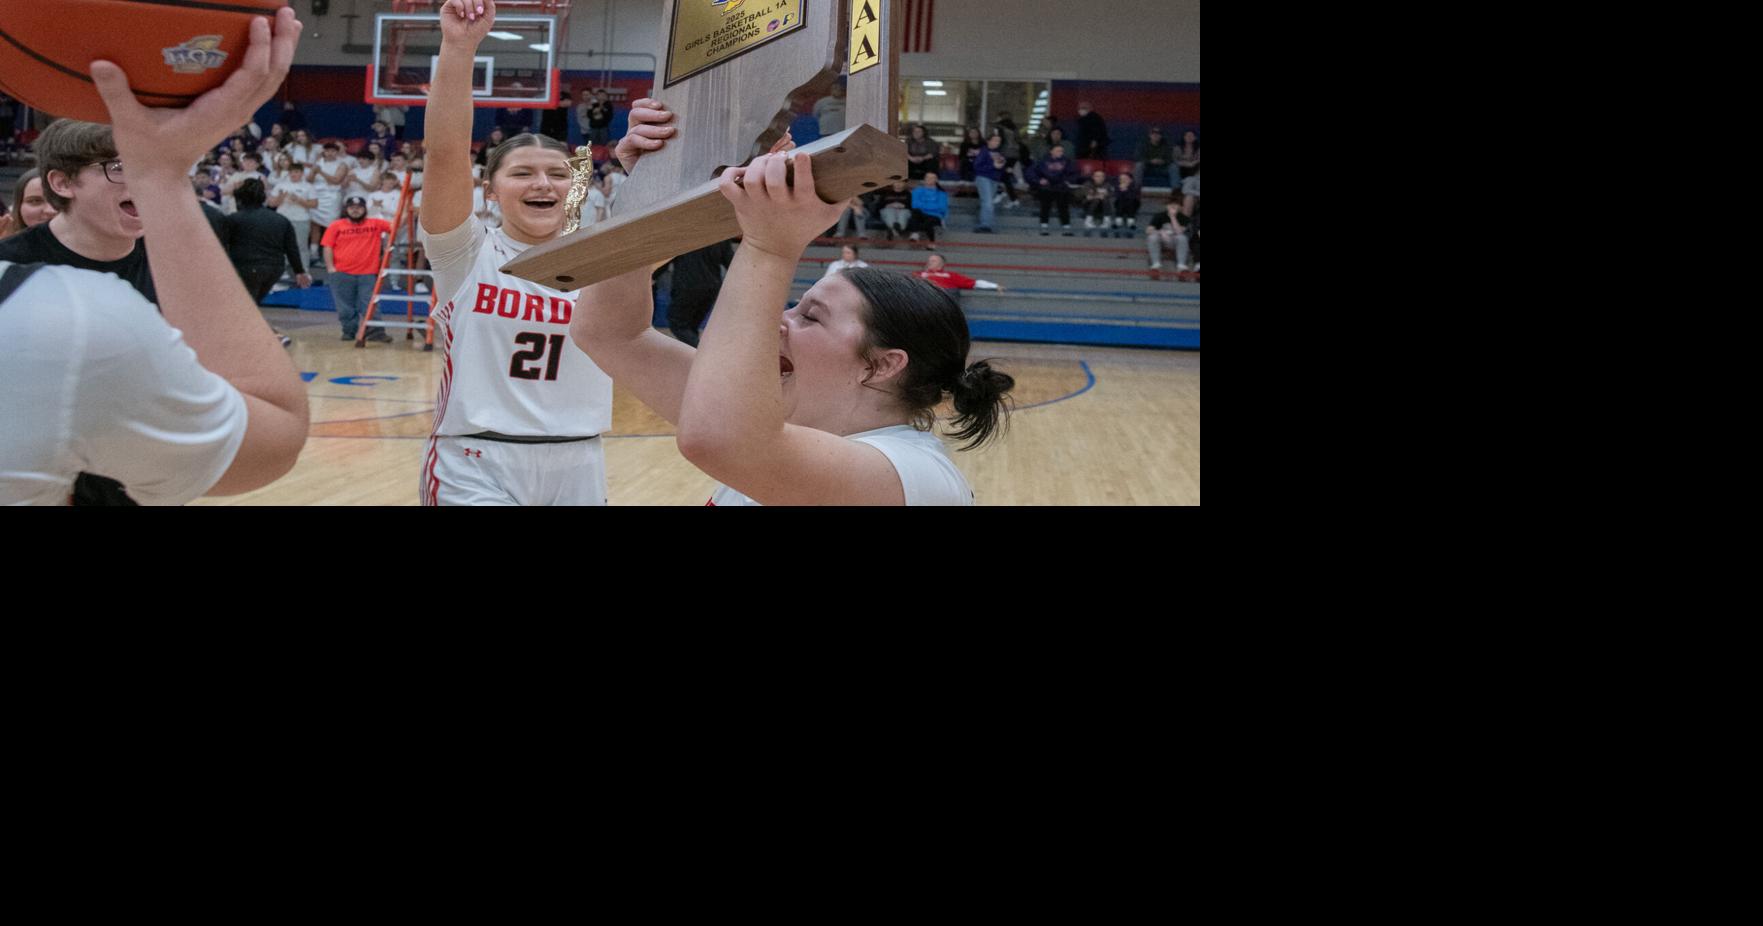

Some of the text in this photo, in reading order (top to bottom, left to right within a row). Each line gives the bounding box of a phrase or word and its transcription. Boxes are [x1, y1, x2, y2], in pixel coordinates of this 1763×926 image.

[685, 0, 787, 51] GIRLS BASKETBALL 1A
[711, 23, 757, 47] REGIONAL
[726, 11, 745, 24] 2025
[706, 28, 760, 57] CHAMPIONS
[472, 282, 577, 325] BORD
[509, 331, 565, 381] 21
